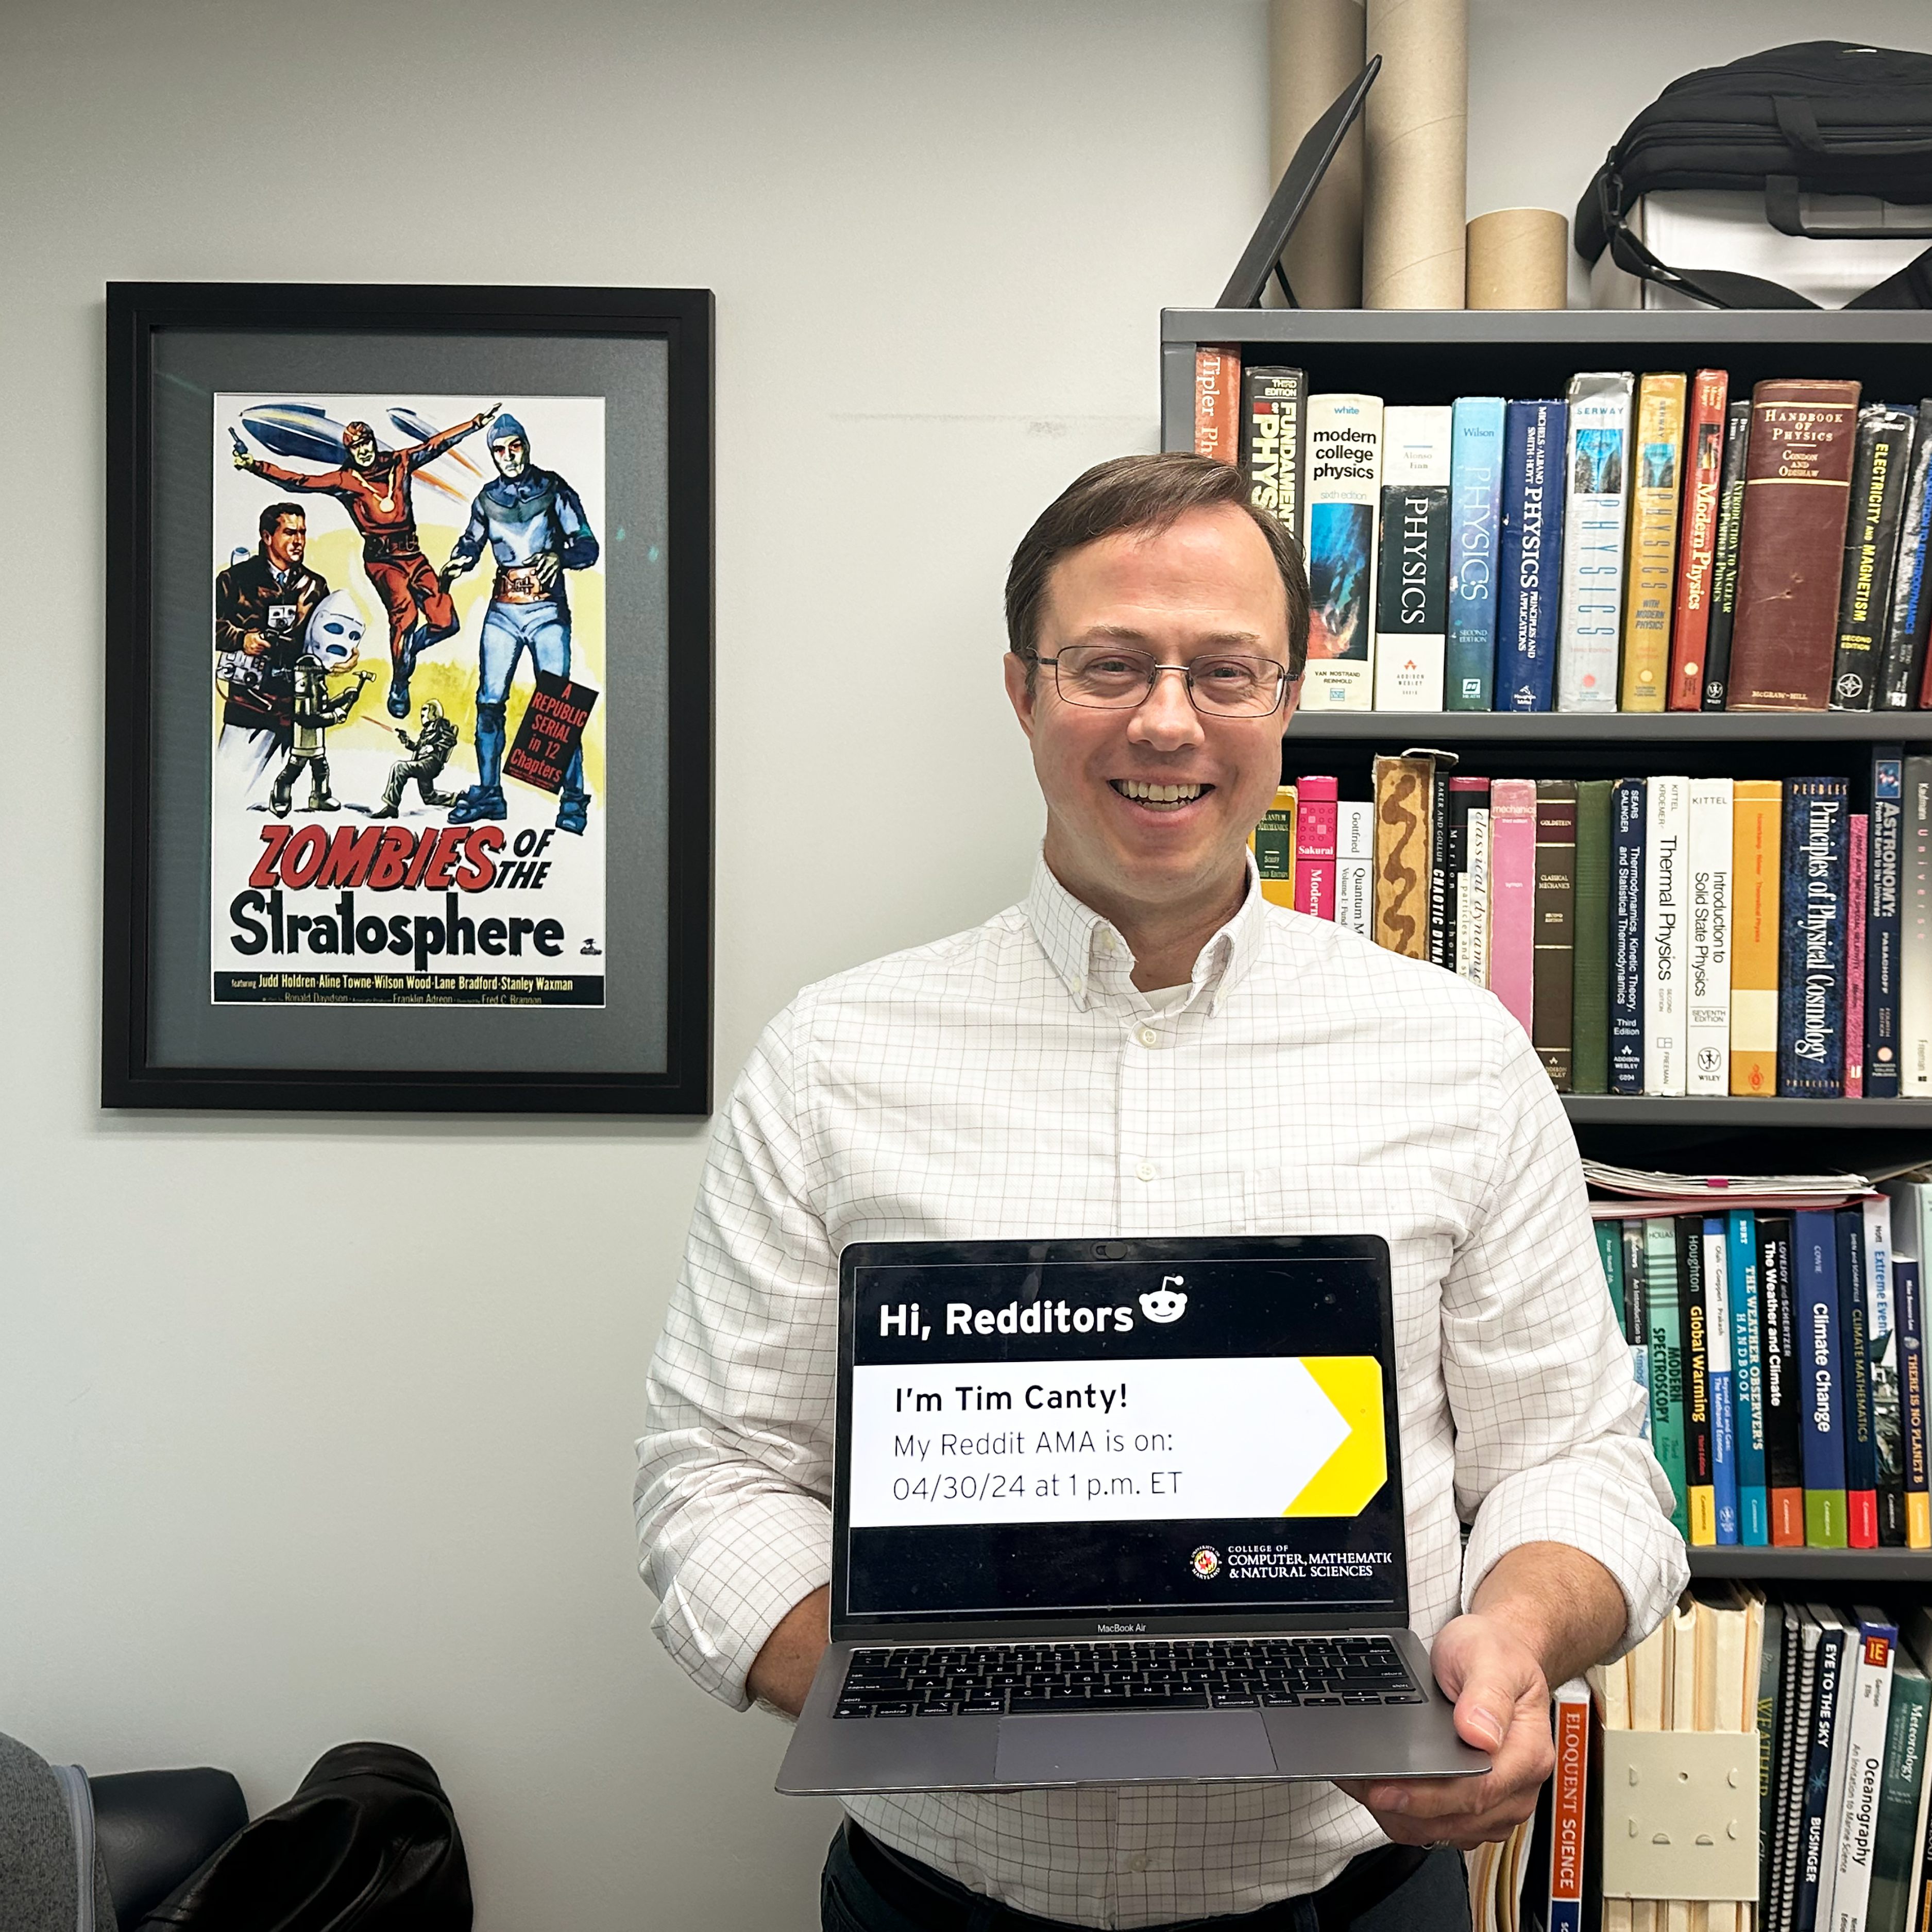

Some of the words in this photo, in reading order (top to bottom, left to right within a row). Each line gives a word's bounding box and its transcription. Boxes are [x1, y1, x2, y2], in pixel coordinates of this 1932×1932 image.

[1197, 357, 1221, 417] Tipler
[1265, 388, 1297, 397] EDITION
[1272, 379, 1297, 388] THIRD
[1463, 427, 1495, 437] Wilson
[1577, 407, 1624, 416] SERWAY
[1765, 409, 1843, 422] HANDBOOK
[1795, 422, 1812, 430] OF
[1314, 428, 1376, 444] modern
[1315, 445, 1373, 463] college
[1772, 428, 1833, 441] PHYSICS
[1314, 463, 1374, 481] physics
[1868, 443, 1889, 524] ELECTRICITY
[1461, 467, 1492, 601] PHYSICS
[1692, 481, 1716, 549] Modern
[1727, 480, 1745, 551] INTRODUCTION
[1863, 524, 1874, 540] AND
[1520, 486, 1544, 588] PHYSICS
[1640, 494, 1674, 590] PHYSICS
[1716, 513, 1732, 560] PARTICLE
[1401, 497, 1429, 624] PHYSICS
[1577, 498, 1620, 635] PHYSICS
[1685, 550, 1711, 611] Physics
[1726, 553, 1736, 567] TO
[1712, 562, 1726, 602] PHYSICS
[1722, 569, 1738, 613] NUCLEAR
[1853, 544, 1875, 622] MAGNETISM
[532, 692, 587, 727] REPUBLIC
[562, 684, 572, 700] A
[528, 734, 540, 752] in
[545, 741, 560, 759] 12
[532, 714, 570, 742] SERIAL
[511, 749, 562, 782] Chapters
[1493, 805, 1536, 814] mechanics
[1620, 789, 1629, 833] SALINGER
[1631, 789, 1639, 820] SEARS
[1658, 784, 1666, 825] KROEMER
[514, 829, 555, 857] OF
[1298, 845, 1333, 855] Sakurai
[1351, 812, 1361, 853] Gottfried
[1475, 811, 1487, 893] classical
[1800, 801, 1839, 878] Principles
[248, 824, 507, 892] ZOMBIES
[494, 862, 552, 889] THE
[1449, 829, 1458, 889] Marion
[1618, 846, 1628, 866] and
[1658, 835, 1677, 906] Thermal
[1882, 801, 1901, 918] ASTRONOMY:
[1310, 869, 1322, 916] Modern
[1352, 868, 1365, 919] Quantum
[1432, 868, 1445, 925] CHAOTIC
[1617, 868, 1629, 917] Statistical
[1628, 846, 1640, 935] Thermodynamics,
[1695, 872, 1709, 904] Solid
[1807, 882, 1837, 903] of
[1695, 906, 1709, 942] State
[1713, 872, 1727, 947] Introduction
[230, 890, 564, 972] Stratosphere
[1655, 913, 1676, 980] Physics
[1797, 903, 1837, 970] Physical
[1615, 918, 1628, 1005] Thermodynamics
[1629, 937, 1638, 972] Kinetic
[1691, 945, 1708, 997] Physics
[1713, 951, 1726, 963] to
[259, 974, 278, 988] Judd
[536, 977, 572, 990] Waxman
[1614, 1027, 1640, 1036] Edition
[1616, 1019, 1637, 1027] Third
[1794, 976, 1836, 1063] Cosmology
[1686, 1235, 1699, 1293] Houghton
[1765, 1241, 1776, 1267] The
[1874, 1250, 1886, 1299] Extreme
[1745, 1265, 1756, 1294] THE
[1766, 1268, 1778, 1325] Weather
[879, 1303, 931, 1341] Hi,
[946, 1299, 1133, 1336] Redditors
[1690, 1306, 1705, 1352] Global
[1747, 1295, 1760, 1364] WEATHER
[1768, 1327, 1780, 1353] and
[1813, 1303, 1829, 1366] Climate
[1852, 1308, 1865, 1357] CLIMATE
[1653, 1328, 1670, 1425] SPECTROSCOPY
[1668, 1346, 1682, 1403] MODERN
[1736, 1313, 1750, 1402] HANDBOOK
[1908, 1353, 1919, 1395] THERE
[956, 1385, 1012, 1412] Tim
[1025, 1383, 1129, 1416] Canty!
[1691, 1354, 1707, 1423] Warming
[1769, 1354, 1782, 1407] Climate
[1855, 1358, 1868, 1443] MATHEMATICS
[1910, 1396, 1920, 1406] IS
[1814, 1370, 1832, 1433] Change
[1910, 1408, 1921, 1427] NO
[893, 1435, 931, 1462] My
[941, 1433, 1025, 1456] Reddit
[1036, 1432, 1095, 1454] AMA
[1106, 1430, 1124, 1453] is
[1135, 1433, 1174, 1452] on:
[1911, 1429, 1923, 1474] PLANET
[893, 1474, 1025, 1503] 04/30/24
[1036, 1476, 1059, 1497] at
[1071, 1475, 1078, 1497] 1
[1087, 1478, 1141, 1502] p.m.
[1151, 1472, 1183, 1494] ET
[1913, 1475, 1923, 1483] B
[1228, 1553, 1307, 1566] COMPUTER,
[1229, 1568, 1239, 1578] &
[1241, 1567, 1306, 1578] NATURAL
[1311, 1566, 1372, 1577] SCIENCES
[1097, 1624, 1133, 1633] MacBook
[1135, 1624, 1147, 1633] Air
[1823, 1643, 1837, 1668] EYE
[1822, 1671, 1835, 1690] TO
[1819, 1693, 1833, 1718] THE
[1817, 1720, 1831, 1748] SKY
[1851, 1743, 1861, 1757] An
[1900, 1703, 1923, 1784] Meteorology
[1562, 1712, 1581, 1814] ELOQUENT
[1847, 1759, 1859, 1795] Invitation
[1846, 1798, 1855, 1809] to
[1852, 1758, 1879, 1867] Oceanography
[1843, 1812, 1854, 1841] Marine
[1560, 1818, 1578, 1890] SCIENCE
[1805, 1817, 1822, 1883] BUSINGER
[1840, 1842, 1851, 1874] Science
